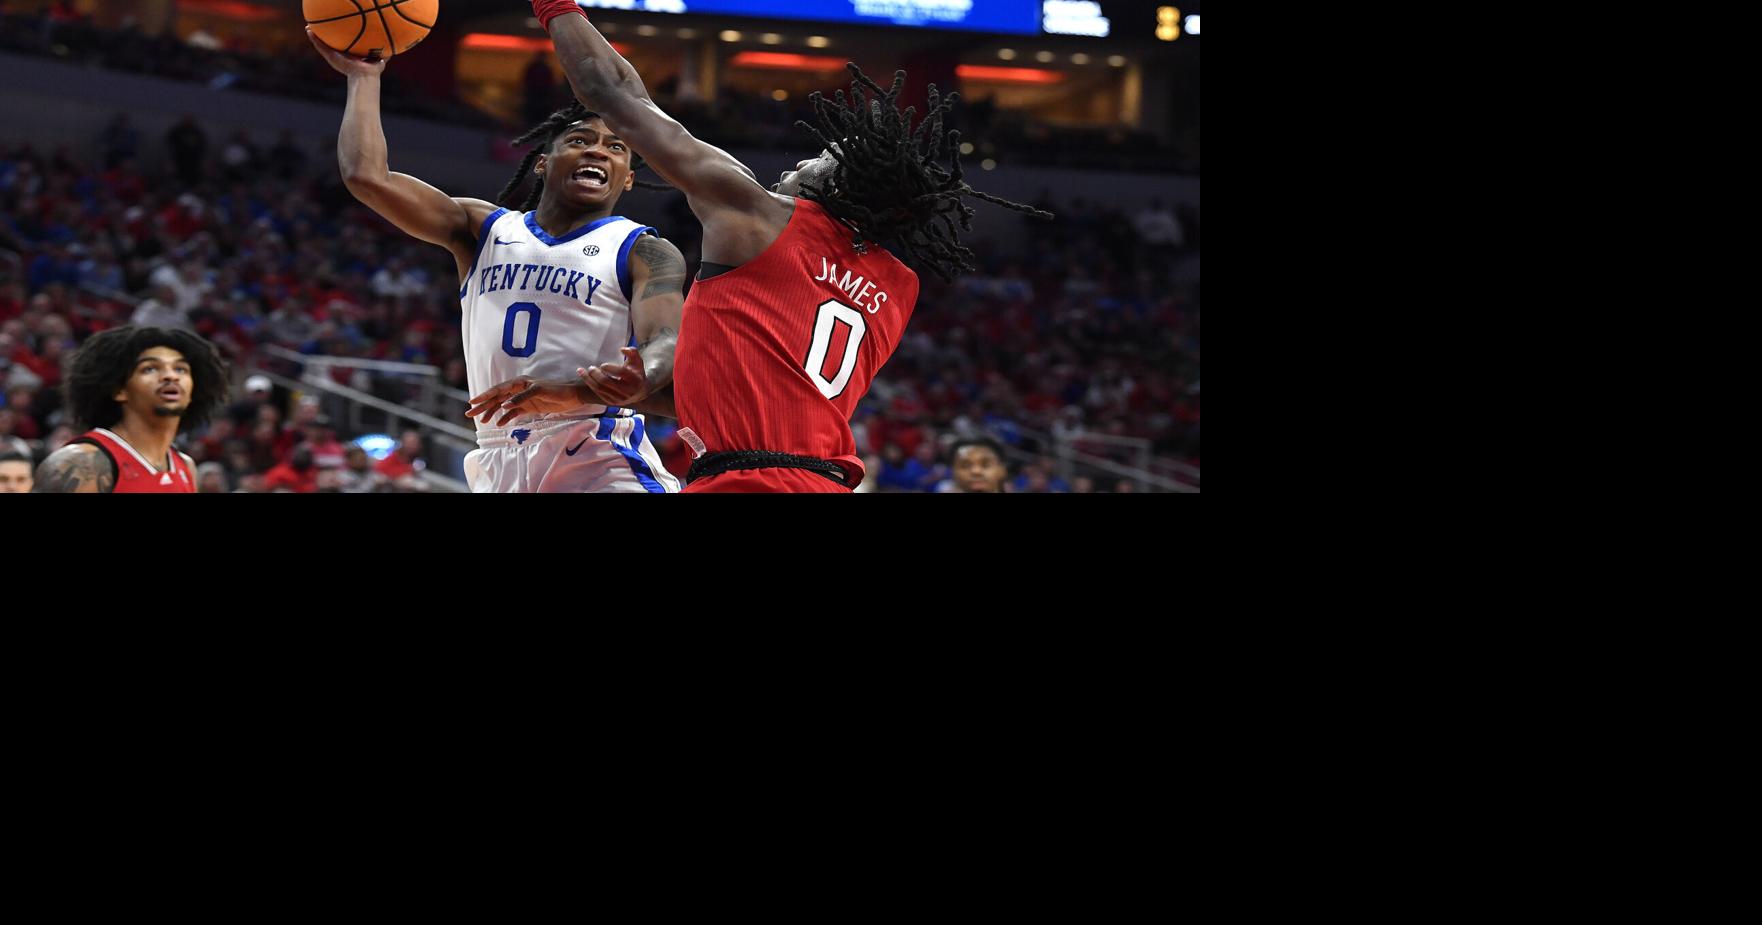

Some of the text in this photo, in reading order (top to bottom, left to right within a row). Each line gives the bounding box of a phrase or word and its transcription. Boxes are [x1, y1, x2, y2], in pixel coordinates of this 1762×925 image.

[583, 245, 600, 256] SEC
[479, 263, 602, 306] KENTUCKY
[815, 257, 888, 314] JAMES
[502, 301, 541, 358] 0
[803, 297, 867, 400] 0
